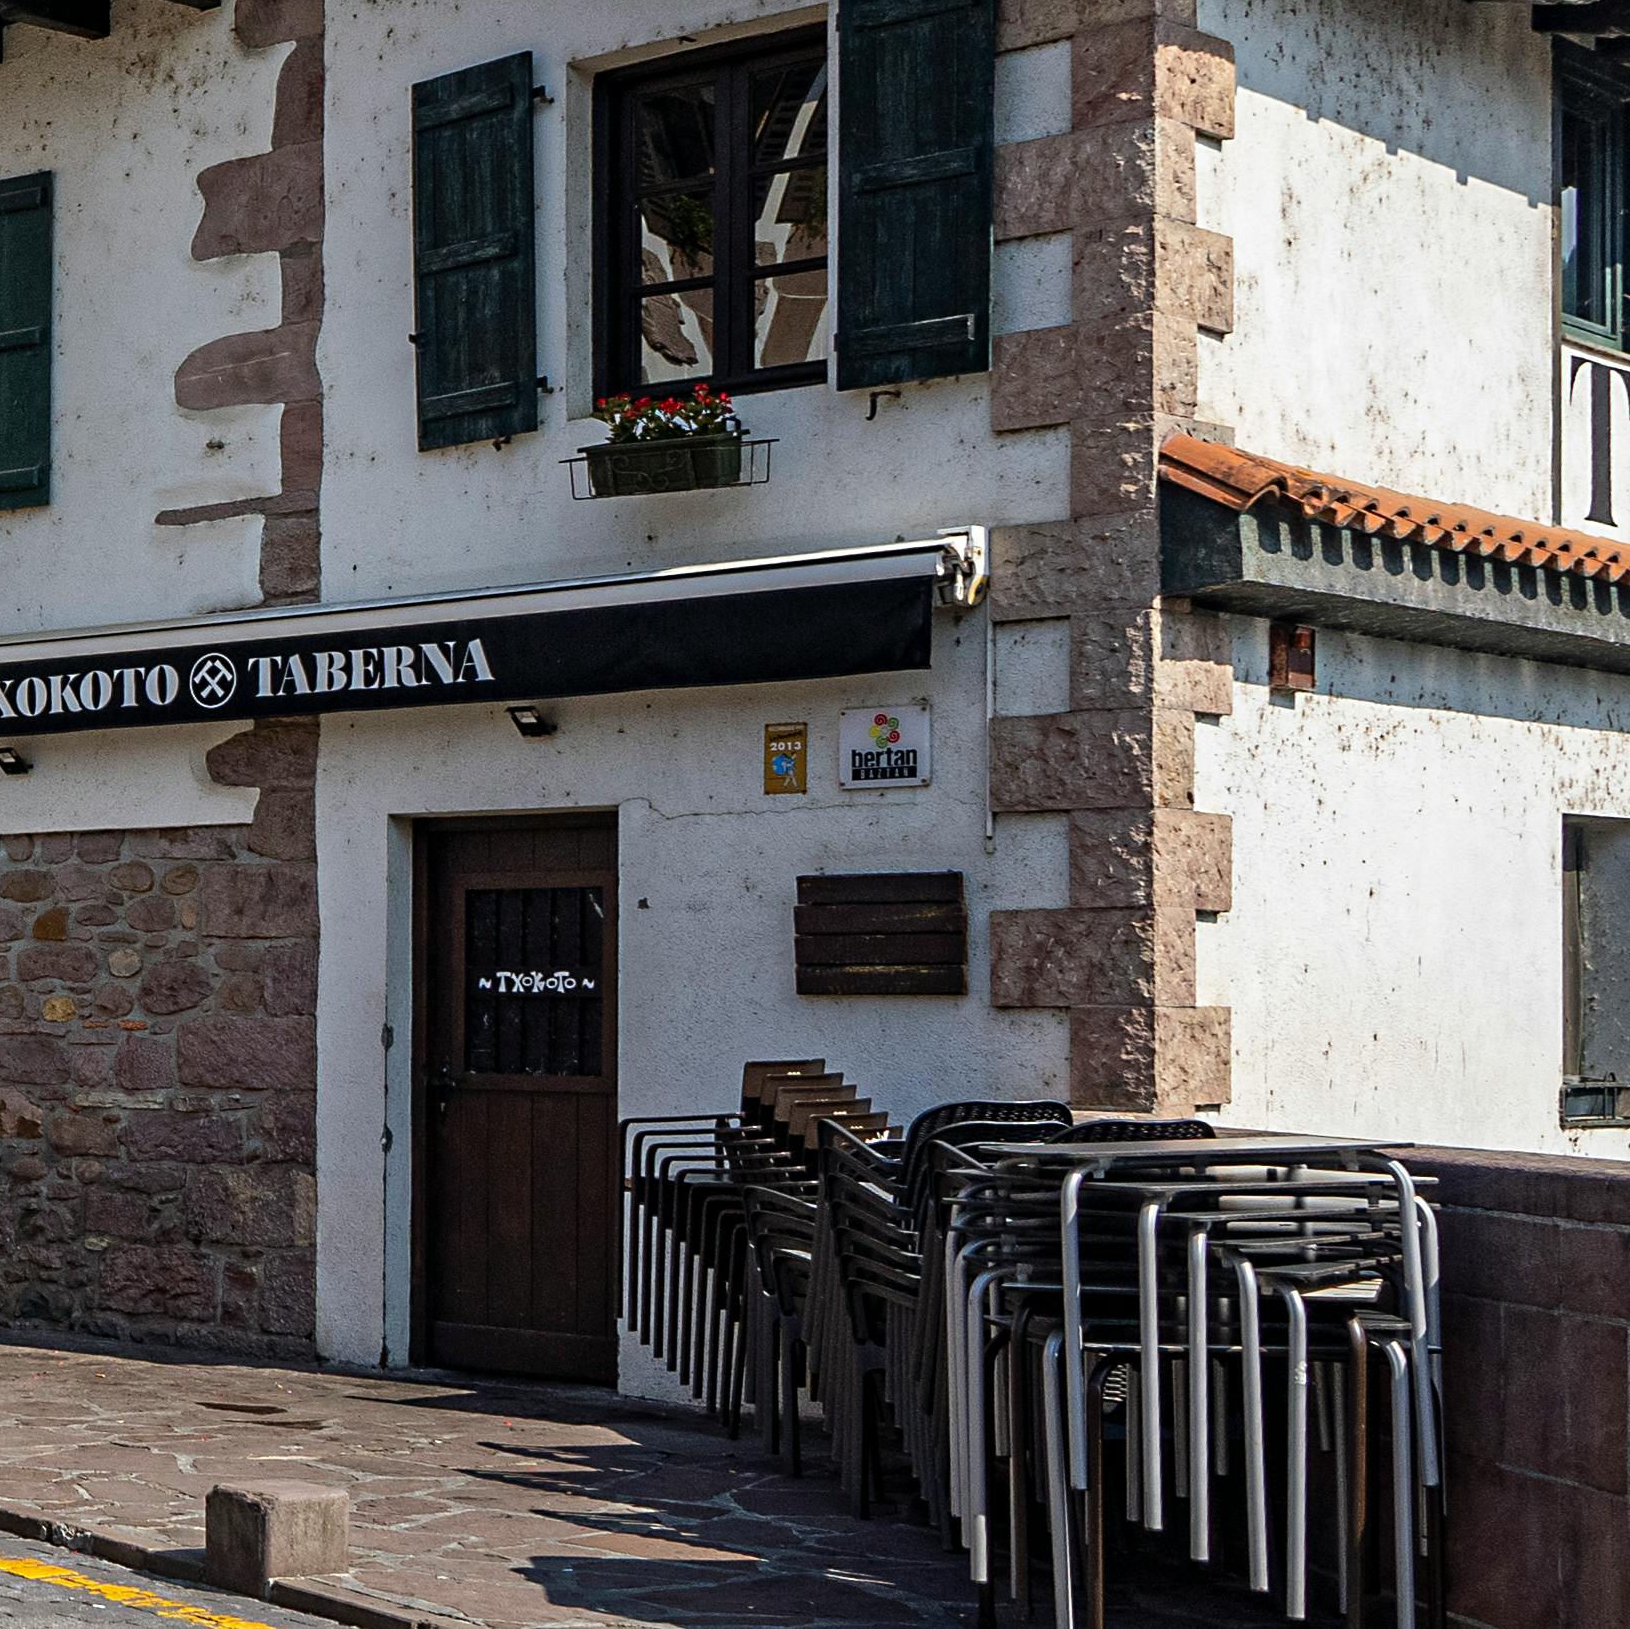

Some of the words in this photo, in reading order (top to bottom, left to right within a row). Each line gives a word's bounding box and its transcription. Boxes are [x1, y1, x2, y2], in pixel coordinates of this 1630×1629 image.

[247, 638, 496, 698] TABERNA
[769, 741, 802, 751] 2013
[851, 747, 918, 768] bertan
